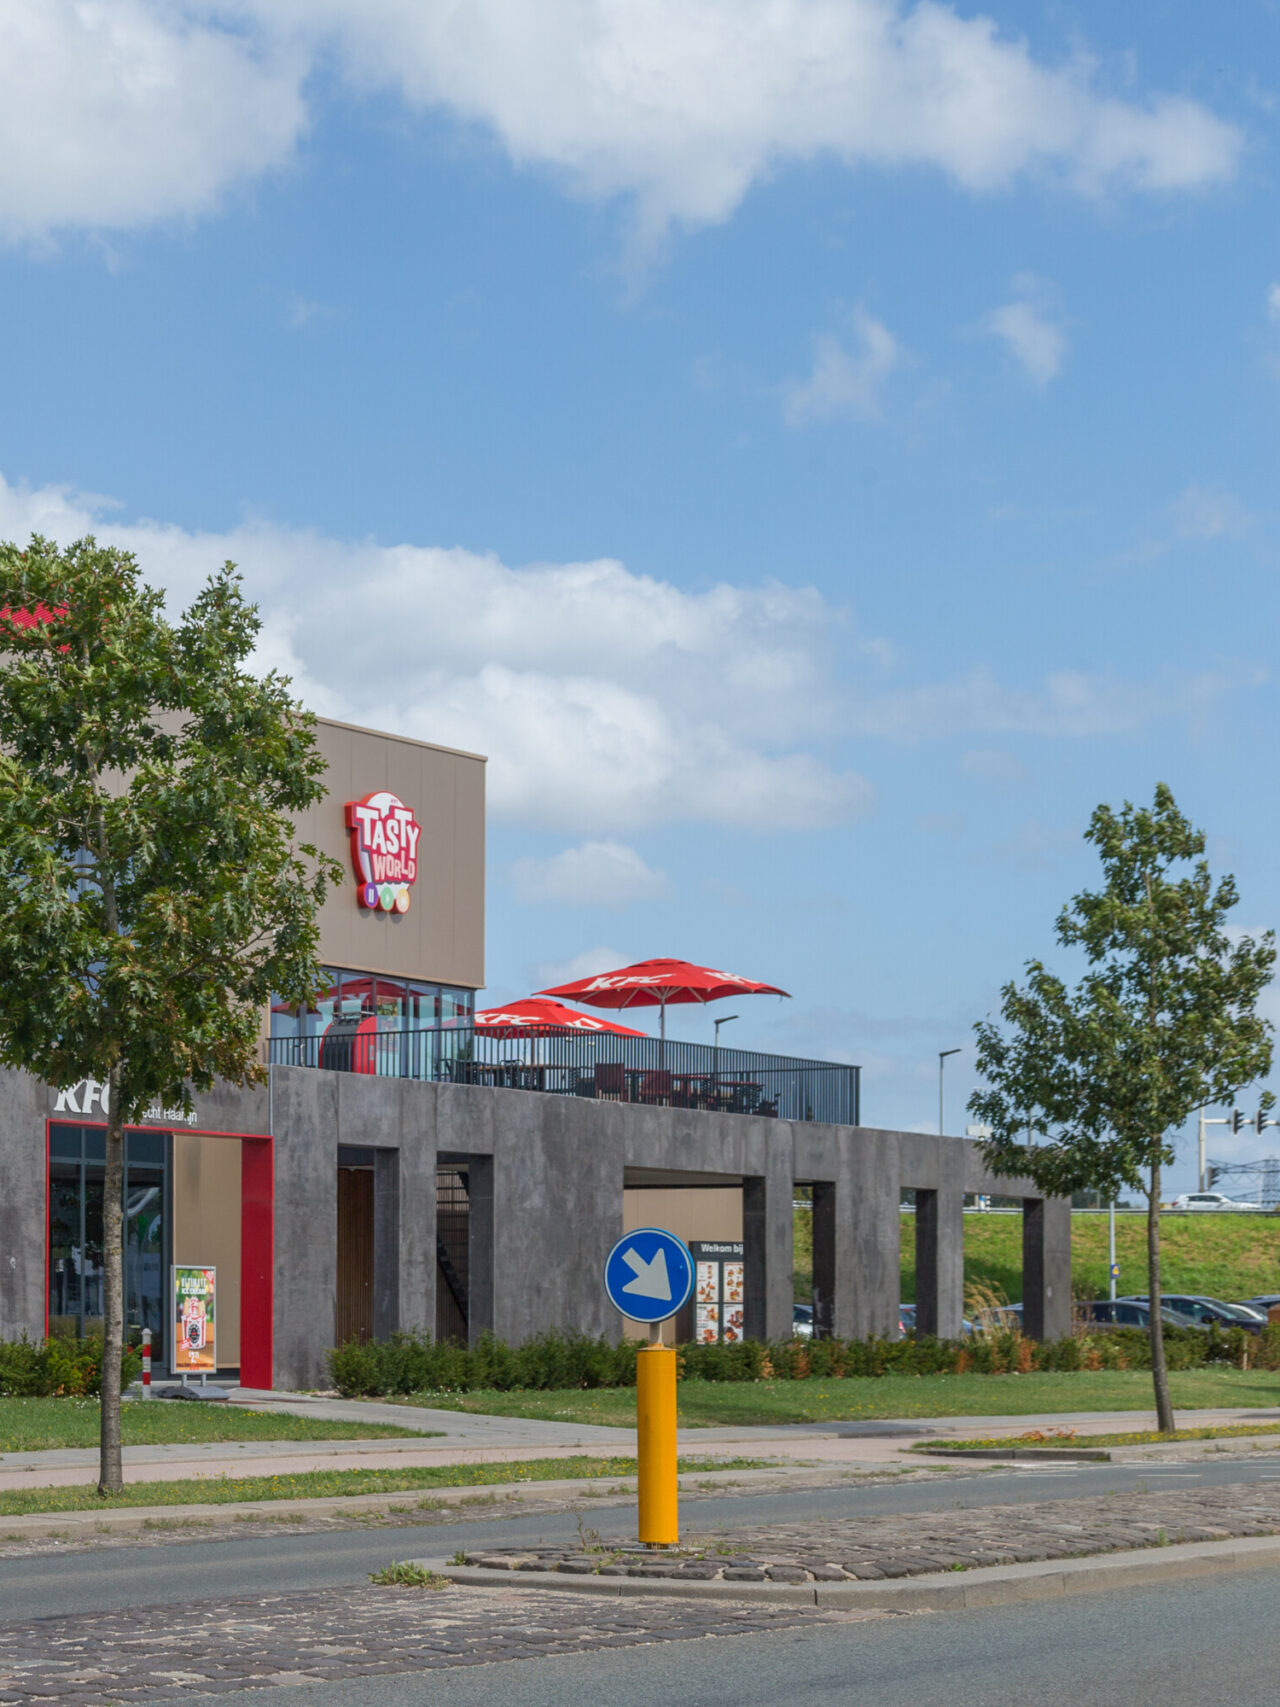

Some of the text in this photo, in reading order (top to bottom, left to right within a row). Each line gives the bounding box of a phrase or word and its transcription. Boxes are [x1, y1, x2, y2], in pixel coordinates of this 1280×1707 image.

[356, 806, 419, 859] TASTY
[373, 851, 415, 881] WORLD
[581, 974, 675, 991] KFC
[701, 1243, 732, 1253] Welkom
